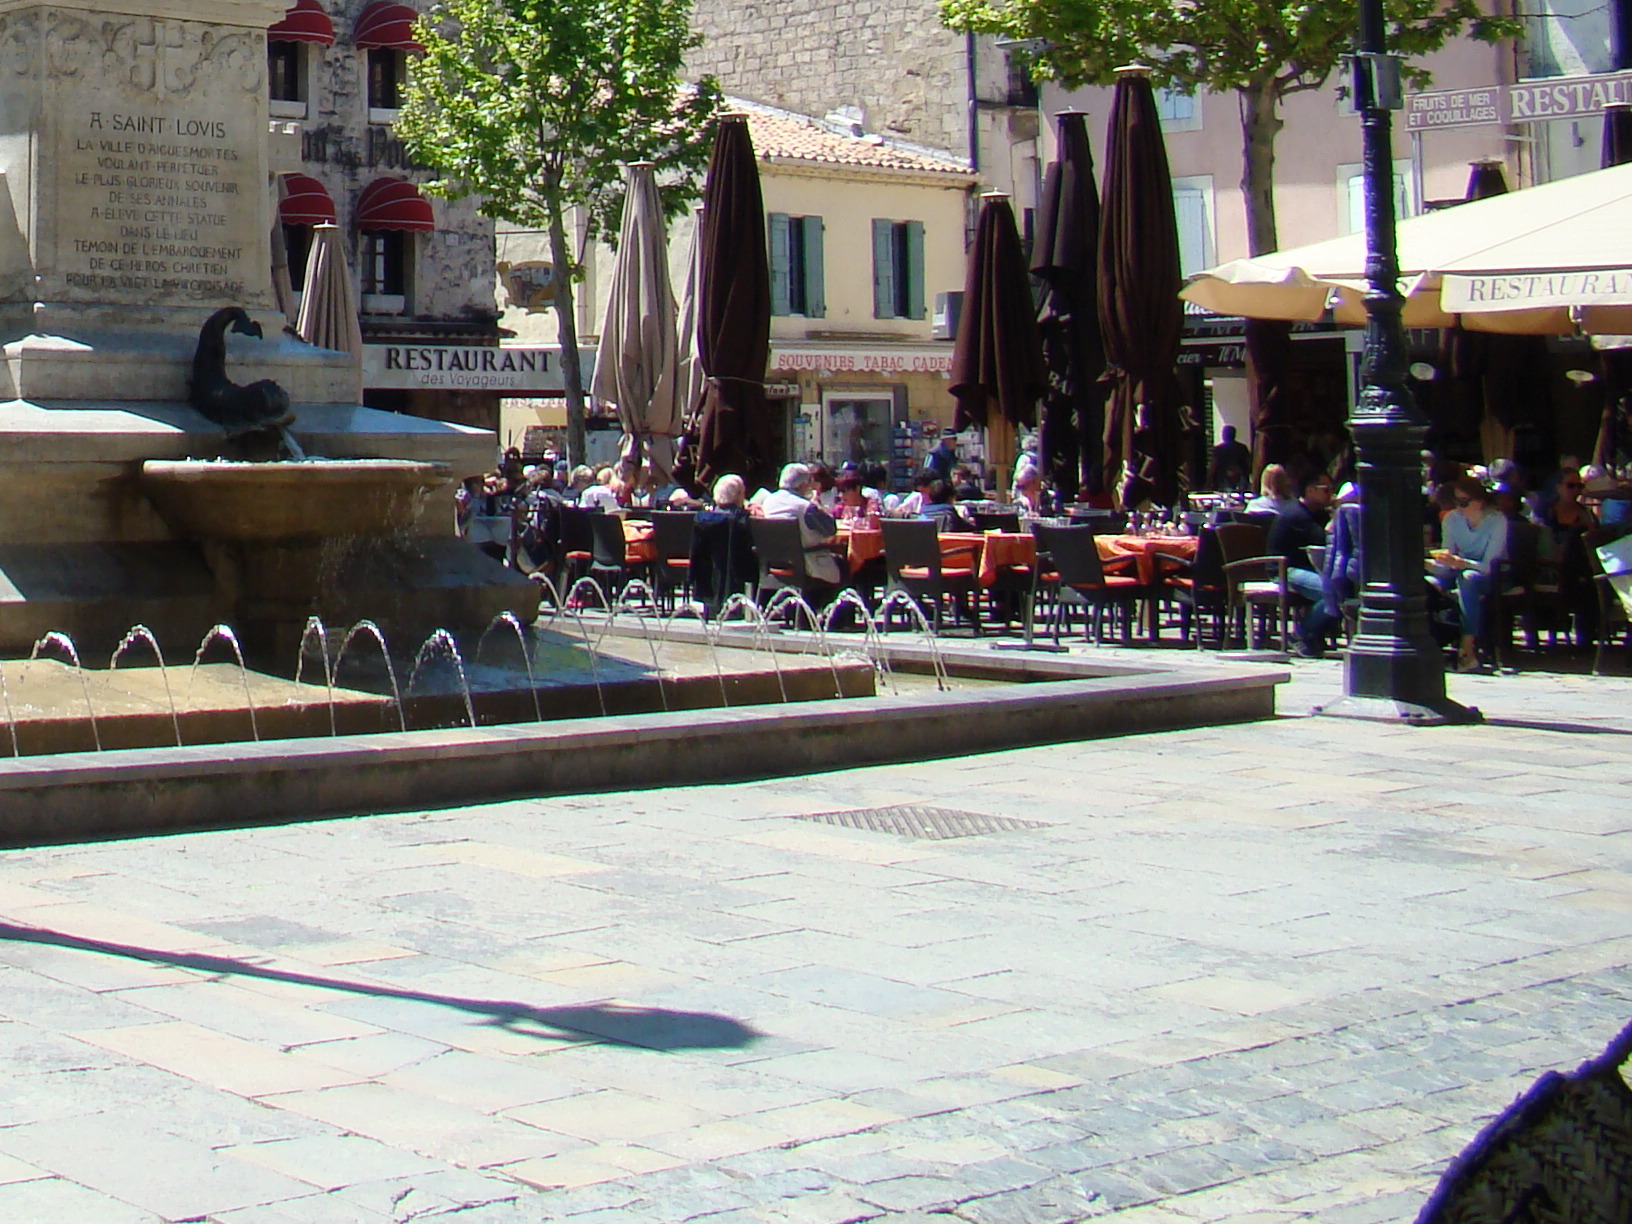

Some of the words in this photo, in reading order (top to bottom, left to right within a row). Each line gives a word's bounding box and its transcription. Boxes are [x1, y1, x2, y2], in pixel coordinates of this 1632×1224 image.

[1413, 95, 1447, 111] FRUITS
[1450, 94, 1465, 108] DE
[1469, 92, 1490, 106] MER
[1409, 113, 1423, 126] ET
[1426, 106, 1497, 125] COQUILLAGES
[112, 114, 166, 134] SAINT
[177, 118, 226, 139] LOVIS
[76, 139, 93, 151] LA
[100, 140, 133, 154] VILLE
[97, 157, 150, 172] VOULANT
[156, 161, 219, 176] PERPETUER
[75, 172, 89, 185] LE
[93, 173, 122, 187] PLUS
[125, 175, 180, 191] GLORIEUX
[185, 180, 239, 195] SOUVENIR
[109, 191, 123, 204] DE
[130, 192, 151, 206] SES
[154, 195, 207, 209] ANNALES
[144, 210, 182, 224] CETTE
[188, 213, 227, 227] STATUE
[120, 225, 151, 240] DANS
[156, 227, 170, 240] LE
[74, 239, 118, 254] TEMOIN
[123, 242, 137, 255] DE
[89, 257, 104, 270] DE
[110, 258, 125, 271] CE
[386, 347, 553, 373] RESTAURANT
[778, 354, 855, 368] SOUVENIRS
[864, 355, 904, 368] TABAC
[421, 373, 444, 386] des
[449, 373, 516, 390] Voyageurs
